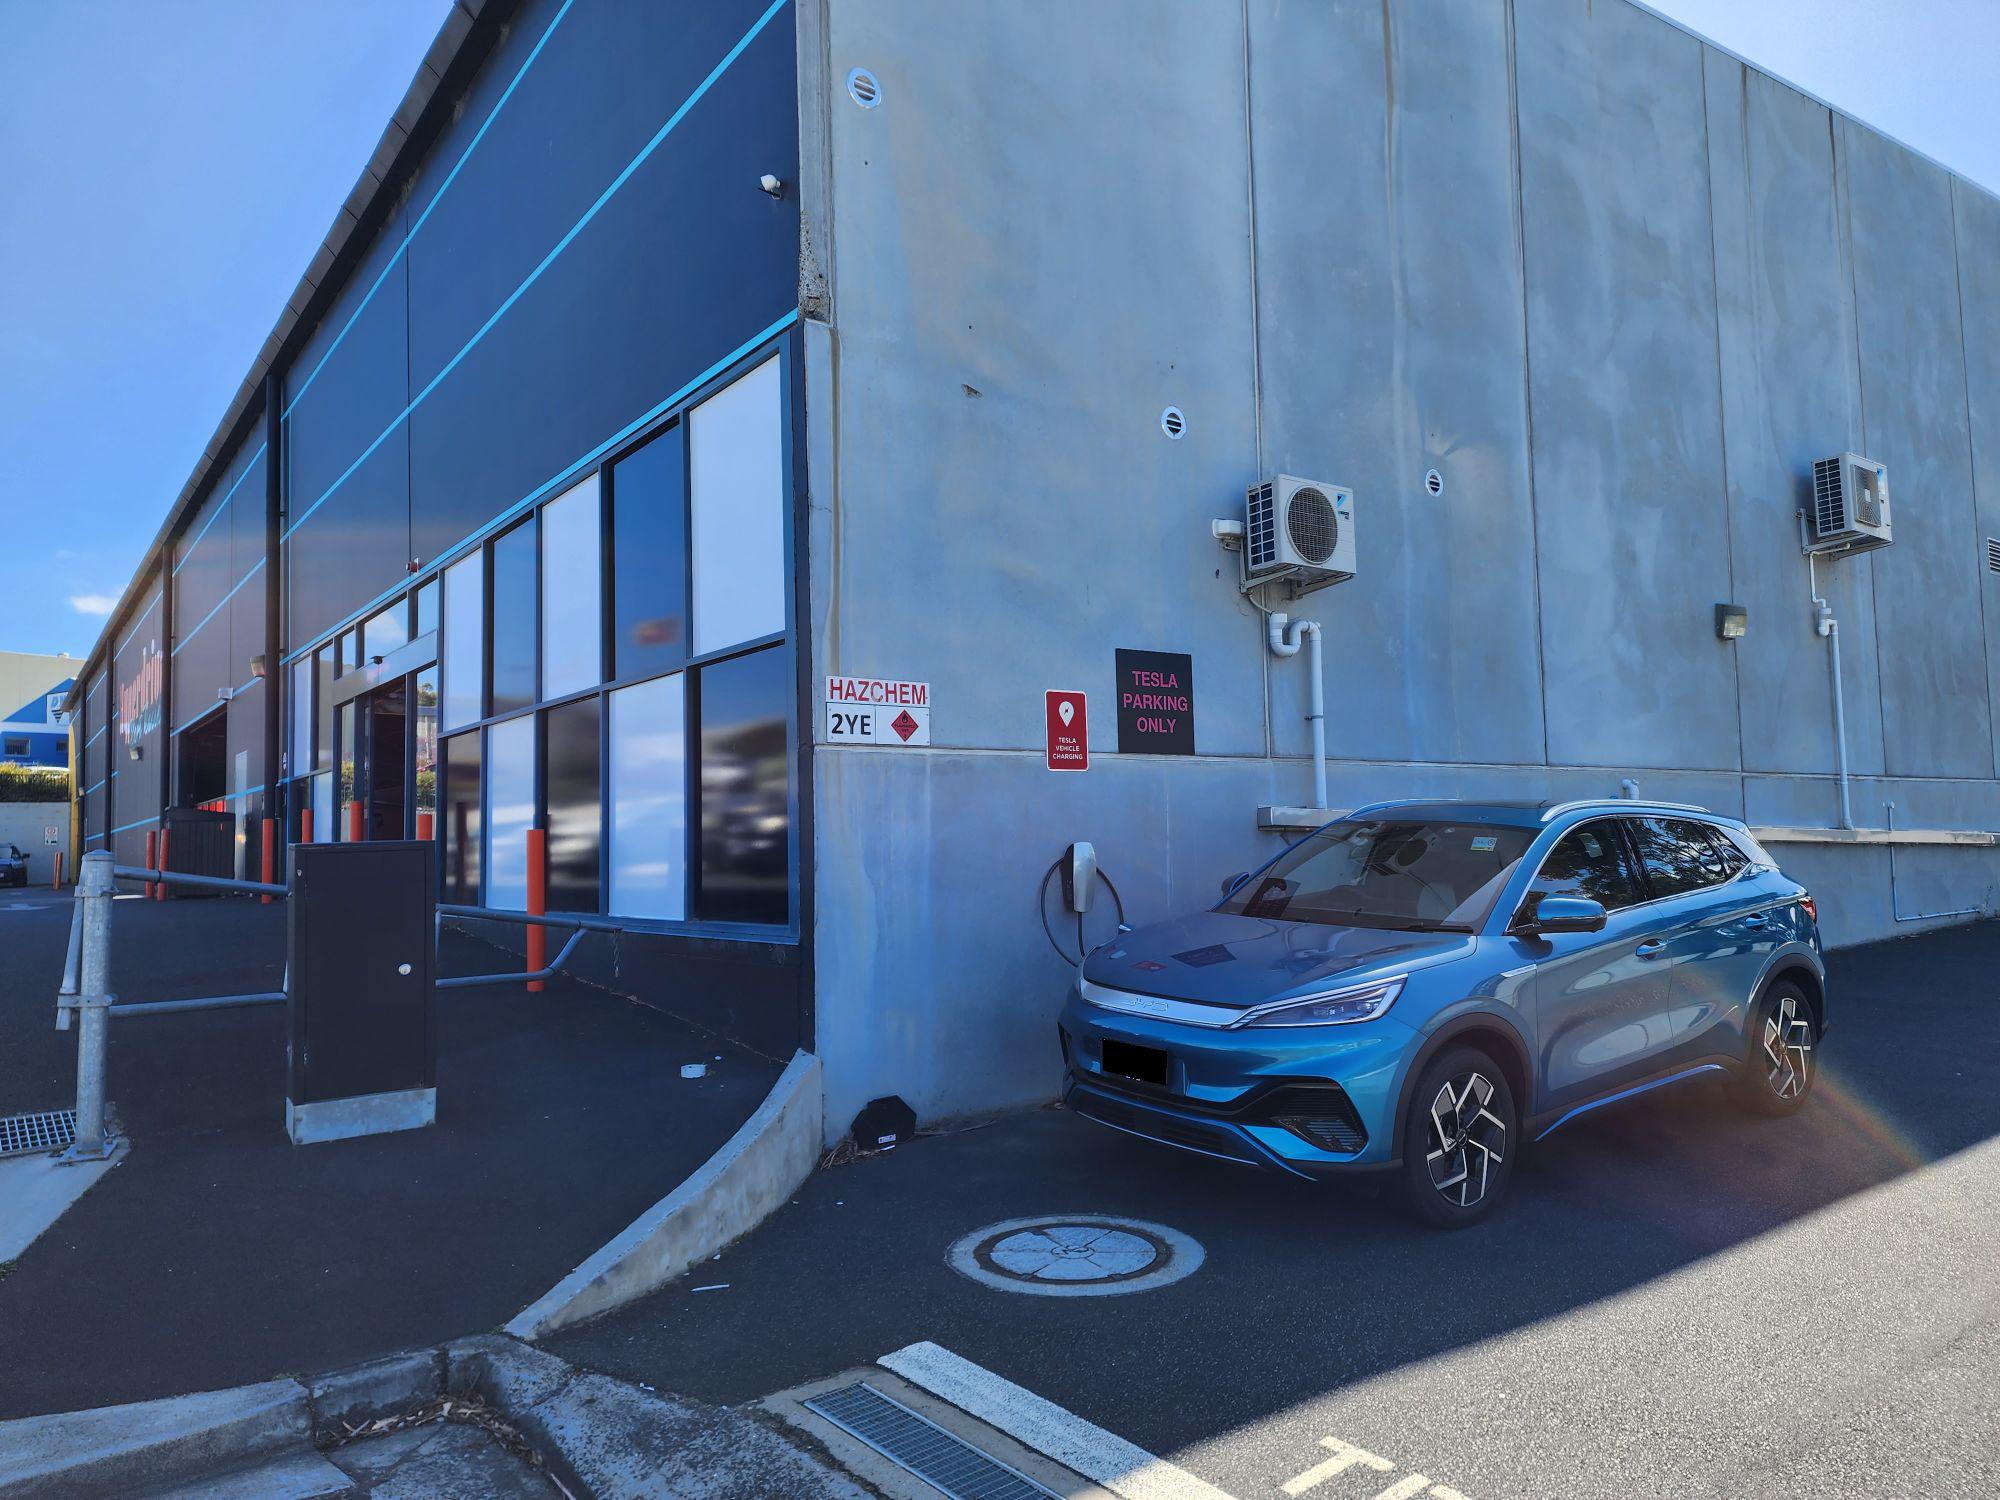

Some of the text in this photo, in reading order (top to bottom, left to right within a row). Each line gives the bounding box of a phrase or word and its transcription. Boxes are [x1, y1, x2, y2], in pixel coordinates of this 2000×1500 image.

[1131, 670, 1178, 688] TESLA
[829, 678, 926, 704] HAZCHEM
[1123, 692, 1188, 711] PARKING
[831, 713, 871, 735] 2YE
[1136, 716, 1177, 733] ONLY
